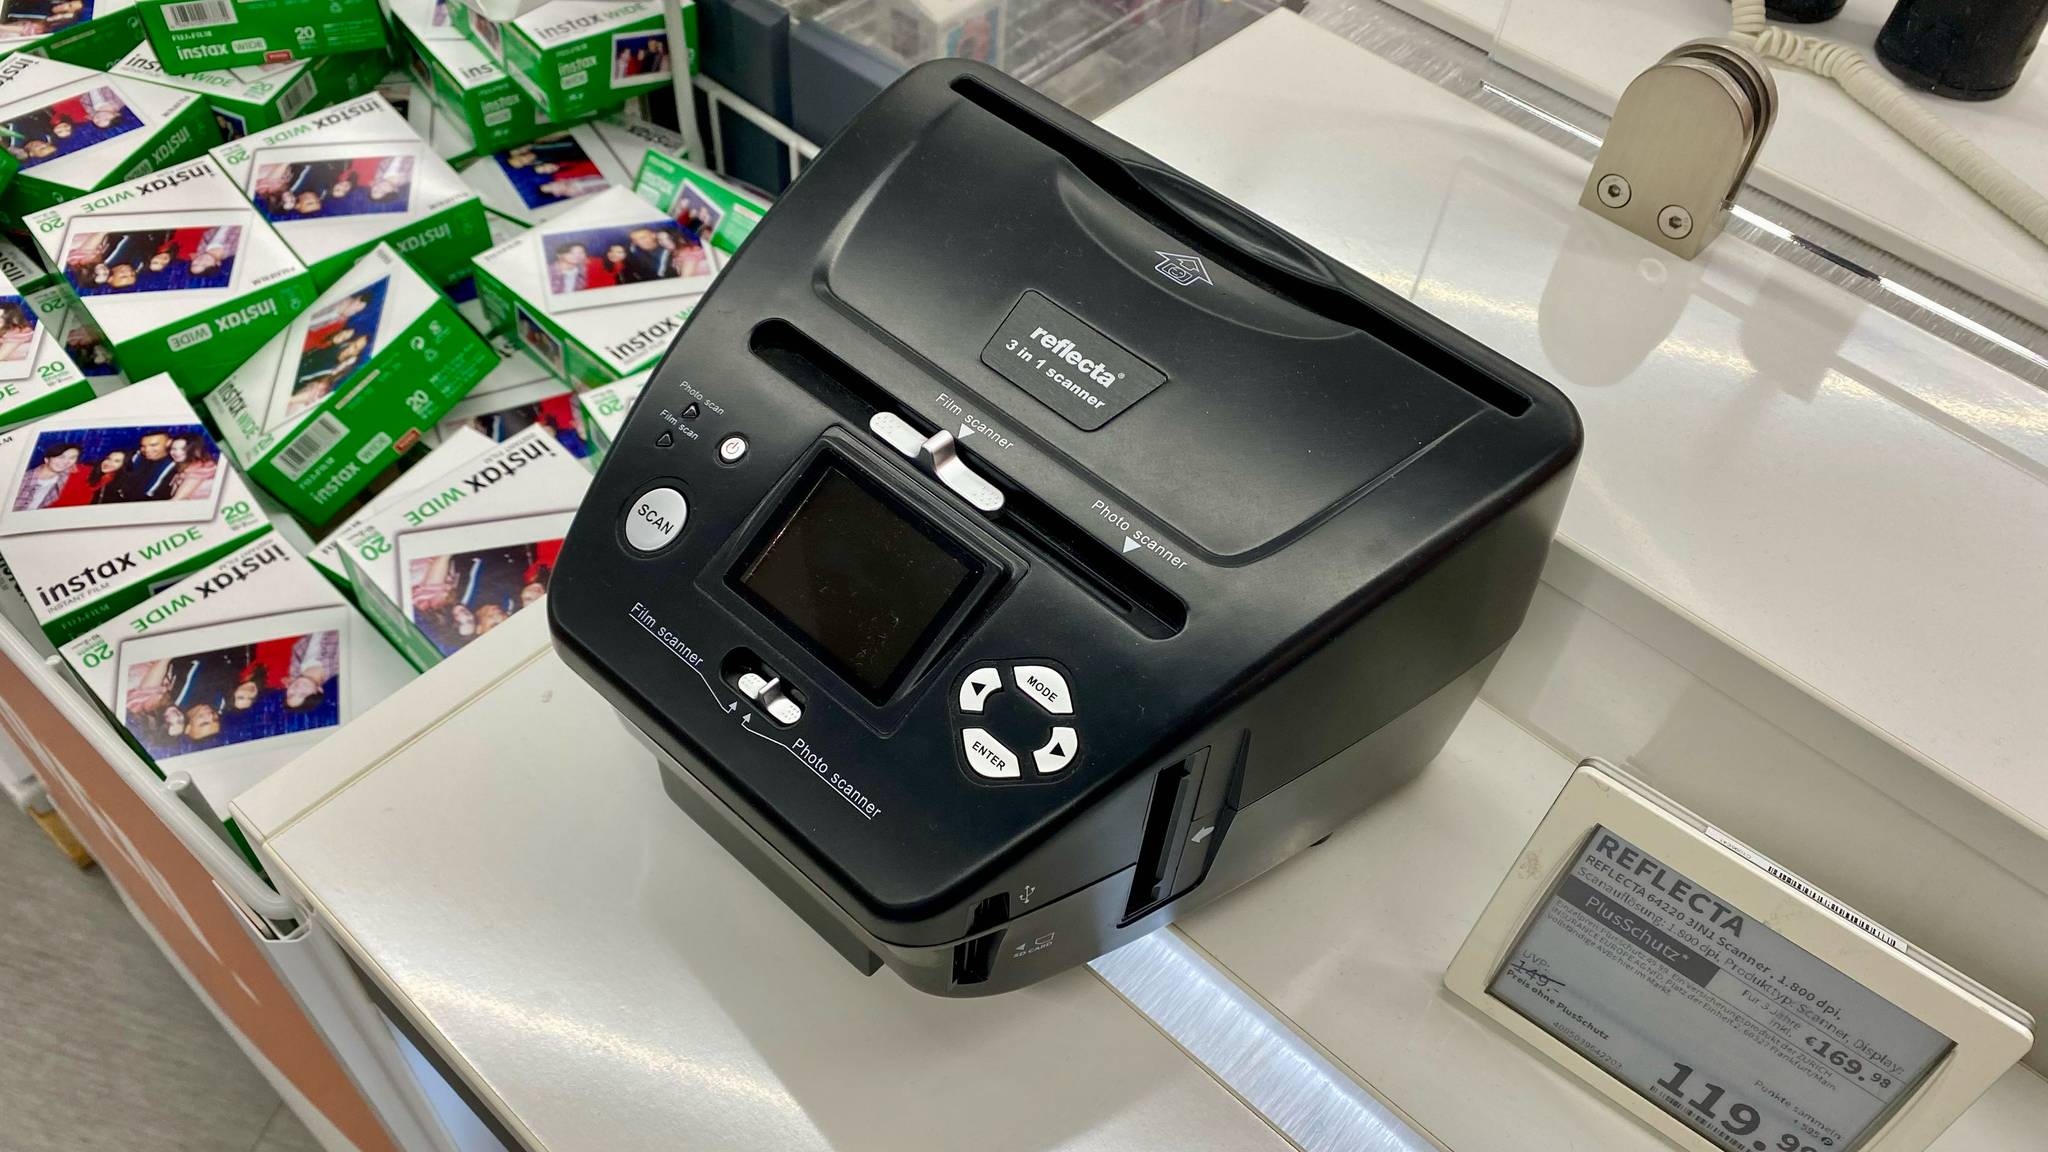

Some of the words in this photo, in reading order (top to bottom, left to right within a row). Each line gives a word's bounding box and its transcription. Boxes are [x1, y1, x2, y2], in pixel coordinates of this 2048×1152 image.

[294, 26, 316, 40] 20
[534, 12, 604, 40] instax
[176, 42, 229, 62] instax
[314, 99, 384, 131] instax
[151, 125, 191, 166] instax
[263, 121, 313, 146] WIDE
[227, 149, 252, 166] 20
[139, 164, 216, 196] instax
[80, 189, 135, 213] WIDE
[40, 216, 65, 233] 20
[397, 222, 450, 252] instax
[41, 299, 65, 313] 20
[215, 298, 278, 332] instax
[172, 327, 209, 348] WIDE
[605, 317, 680, 360] instax
[38, 361, 65, 377] 20
[1005, 339, 1017, 351] 3
[1017, 347, 1033, 363] in
[1035, 358, 1047, 370] 1
[1046, 366, 1106, 410] scanner
[218, 382, 247, 417] instax
[406, 390, 430, 413] 20
[597, 397, 624, 417] 20
[680, 380, 703, 401] Photo
[704, 398, 725, 416] scan
[659, 408, 678, 427] Film
[678, 422, 699, 441] scan
[935, 392, 962, 416] Film
[965, 411, 1014, 451] scanner
[463, 439, 556, 493] instax
[310, 461, 361, 504] instax
[221, 501, 250, 521] 20
[403, 487, 466, 526] WIDE
[638, 504, 674, 535] SCAN
[361, 535, 392, 560] 20
[1091, 499, 1130, 531] Photo
[1133, 529, 1188, 571] scanner
[36, 553, 137, 607] instax
[138, 526, 203, 561] WIDE
[195, 544, 290, 600] instax
[130, 594, 194, 633] WIDE
[630, 601, 656, 628] Film
[657, 625, 704, 667] scanner
[82, 643, 114, 668] 20
[1027, 675, 1058, 703] MODE
[972, 741, 1006, 772] ENTER
[792, 737, 829, 774] Photo
[830, 772, 882, 819] scanner
[1596, 834, 1744, 938] REFLECTA
[1585, 855, 1646, 898] REFLECTA
[1647, 893, 1685, 921] 64220
[1686, 918, 1716, 941] 3IN1
[1777, 975, 1815, 1001] 1.800
[1668, 923, 1699, 946] 1.800
[1507, 970, 1531, 988] Preis
[1531, 986, 1555, 1005] ohne
[1556, 1002, 1610, 1040] PlusSchutz
[1754, 1079, 1792, 1107] Punkte
